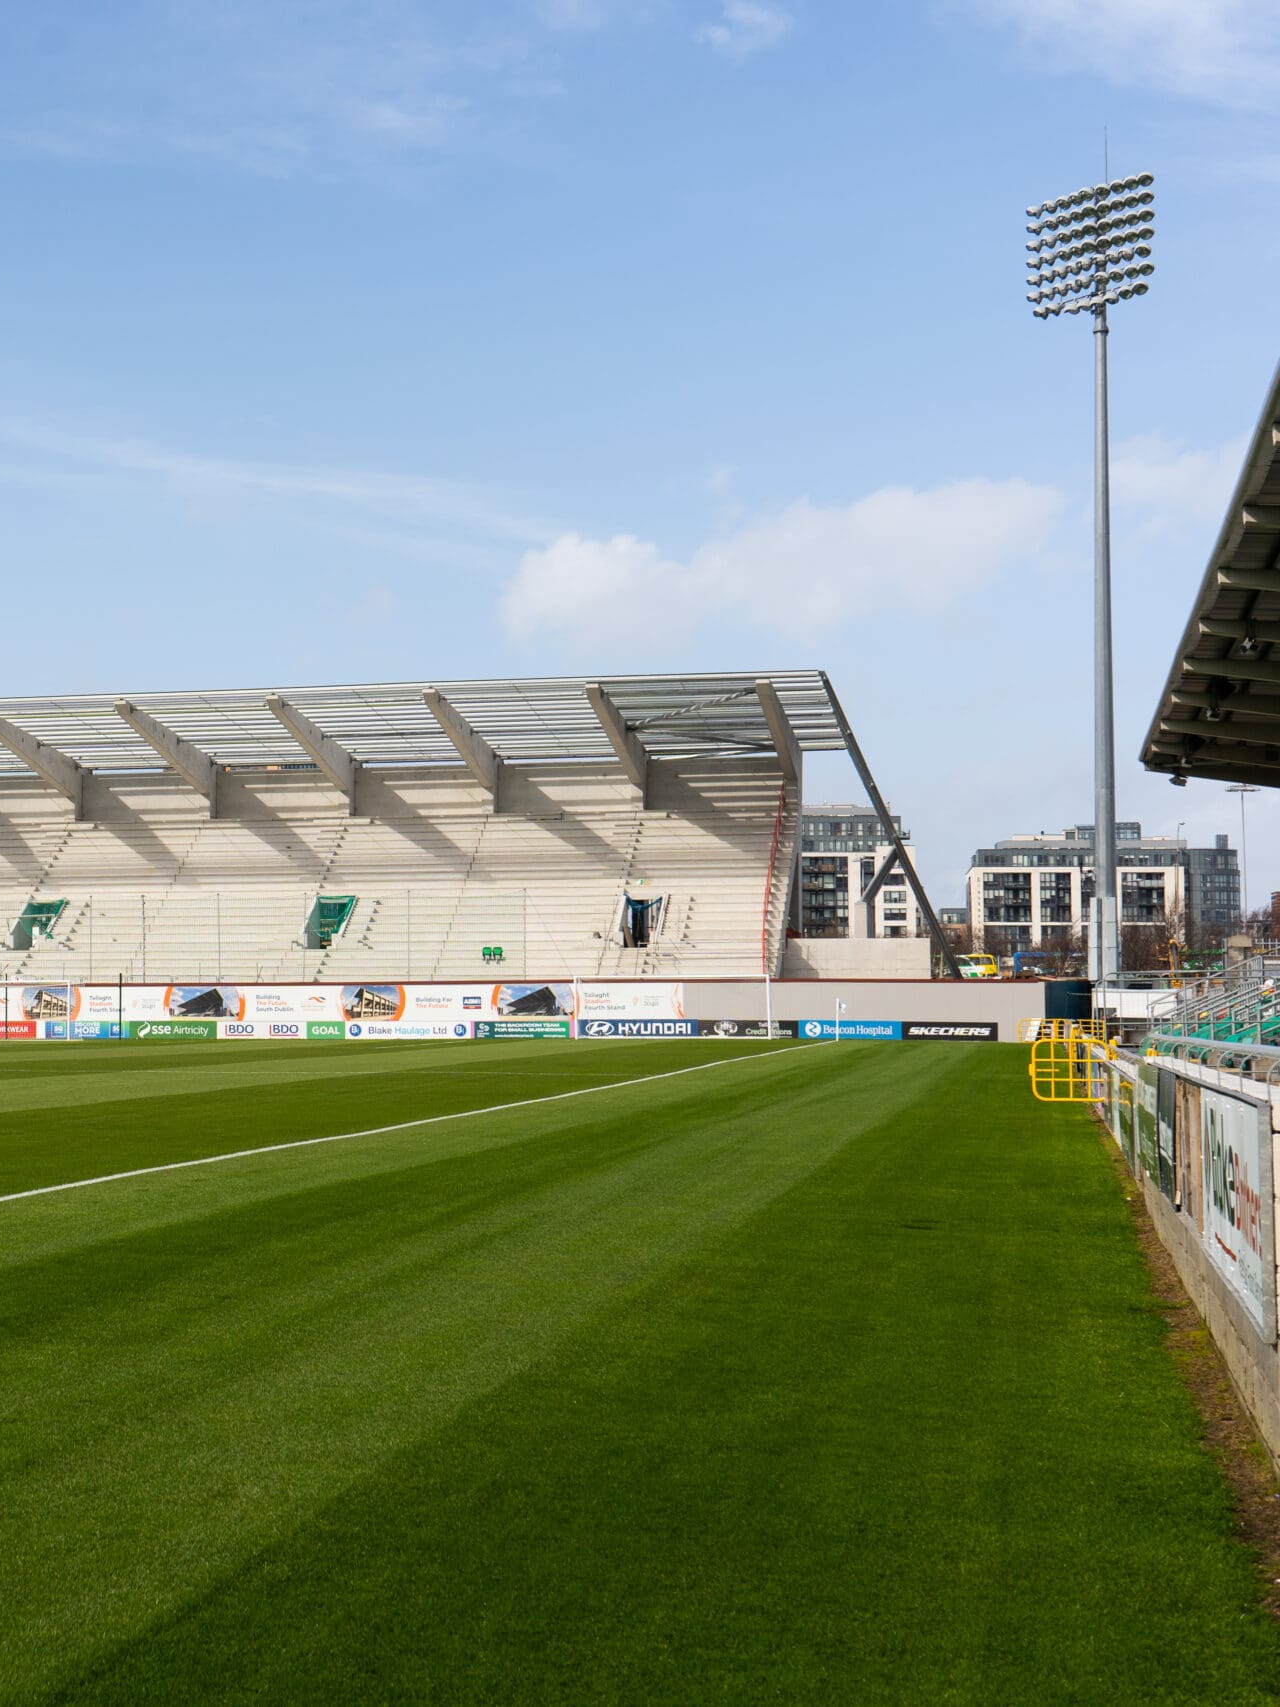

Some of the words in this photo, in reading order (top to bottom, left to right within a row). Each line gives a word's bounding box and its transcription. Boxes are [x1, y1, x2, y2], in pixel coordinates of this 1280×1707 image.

[151, 1025, 171, 1035] sse
[173, 1025, 209, 1037] Airtricity
[228, 1024, 254, 1034] BDO
[272, 1024, 299, 1034] BDO
[312, 1026, 340, 1035] GOAL
[368, 1026, 392, 1035] Blake
[394, 1026, 430, 1036] Haulage
[432, 1026, 447, 1035] Ltd
[618, 1023, 692, 1035] HYUNDAI
[856, 1025, 893, 1036] Hospital
[908, 1026, 992, 1036] SKECHERS
